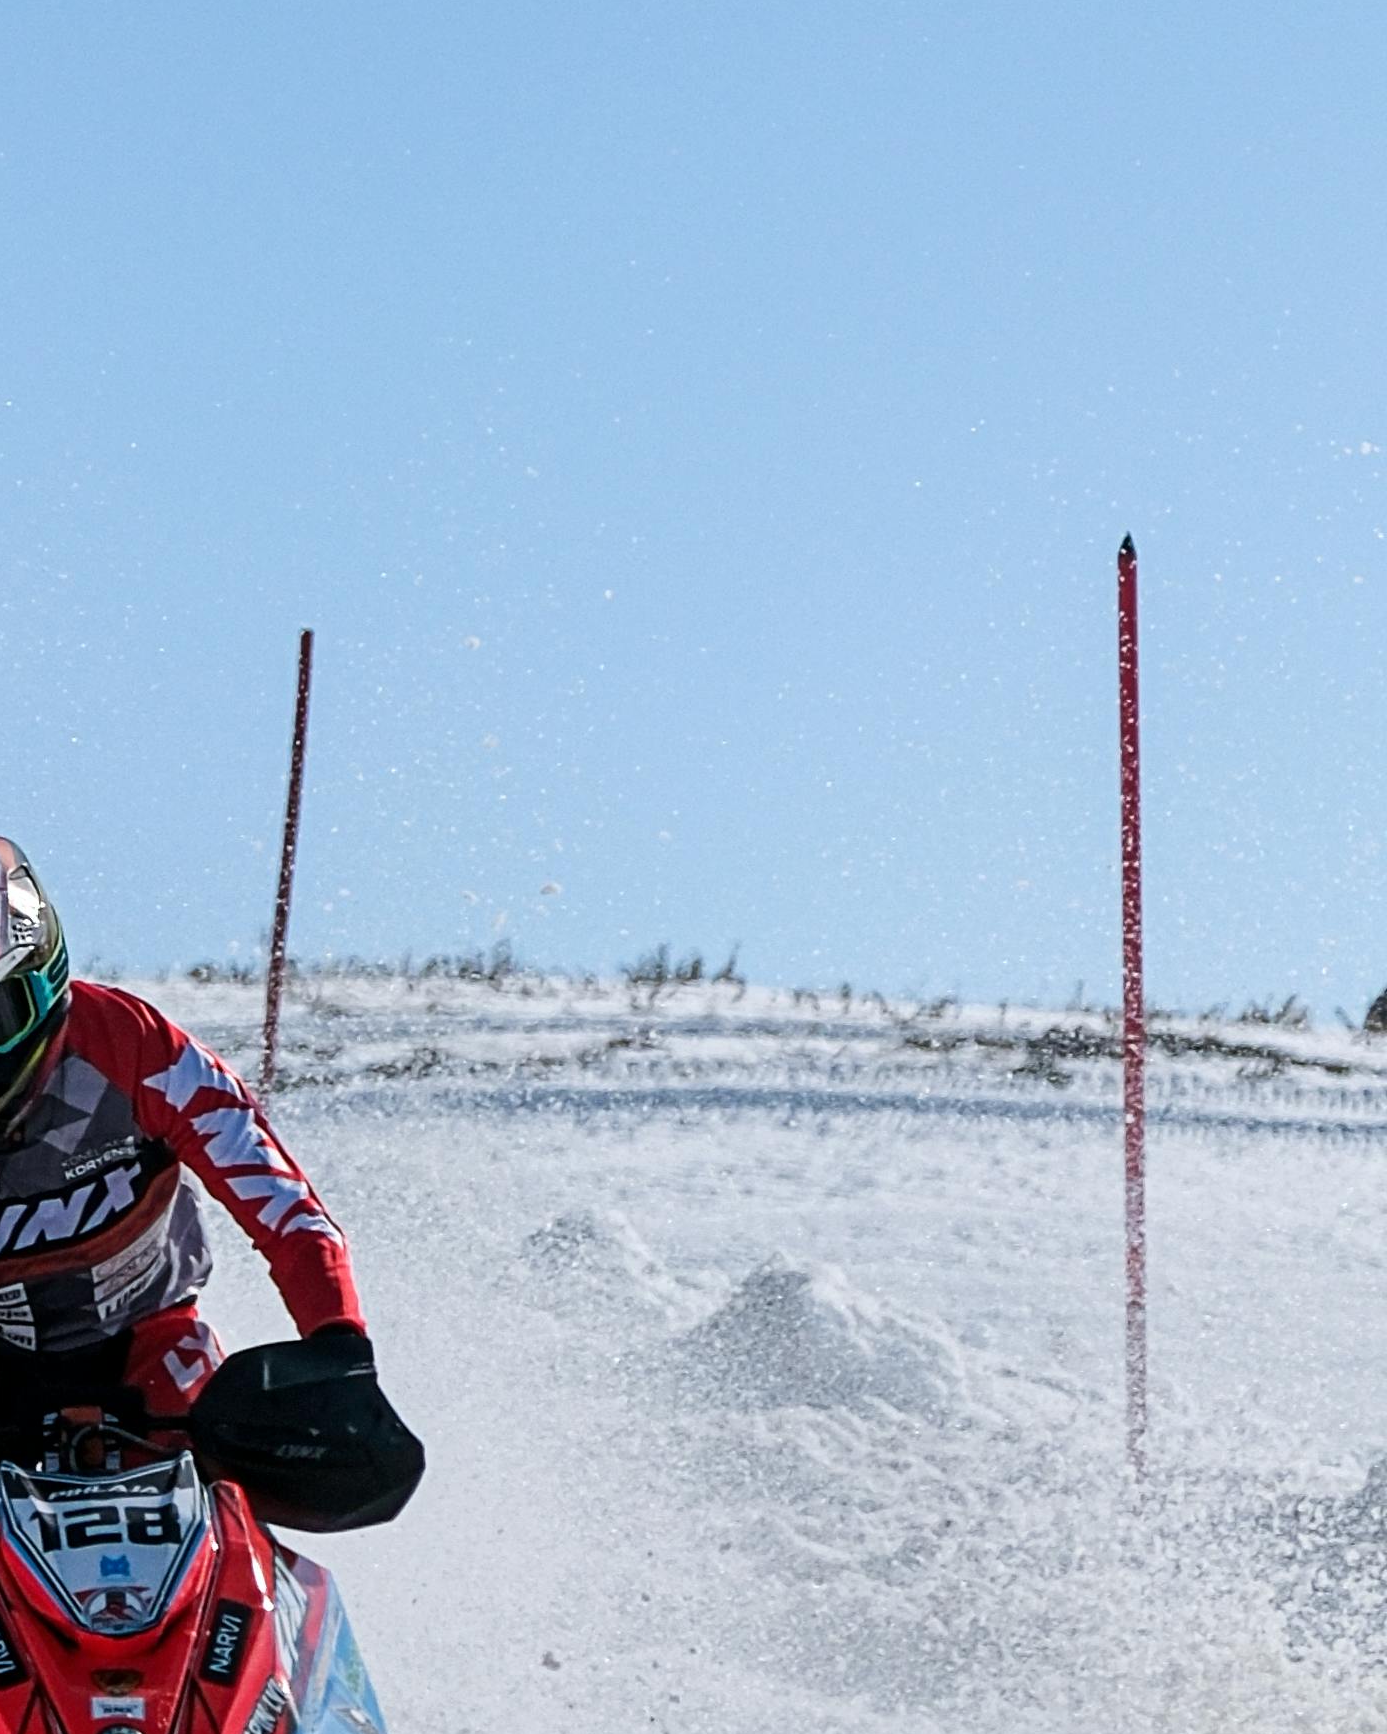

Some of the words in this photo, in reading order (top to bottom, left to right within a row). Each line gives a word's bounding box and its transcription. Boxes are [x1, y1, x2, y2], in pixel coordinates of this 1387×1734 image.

[162, 1320, 228, 1392] LY
[29, 1503, 184, 1553] 128
[210, 1613, 243, 1674] NARVI
